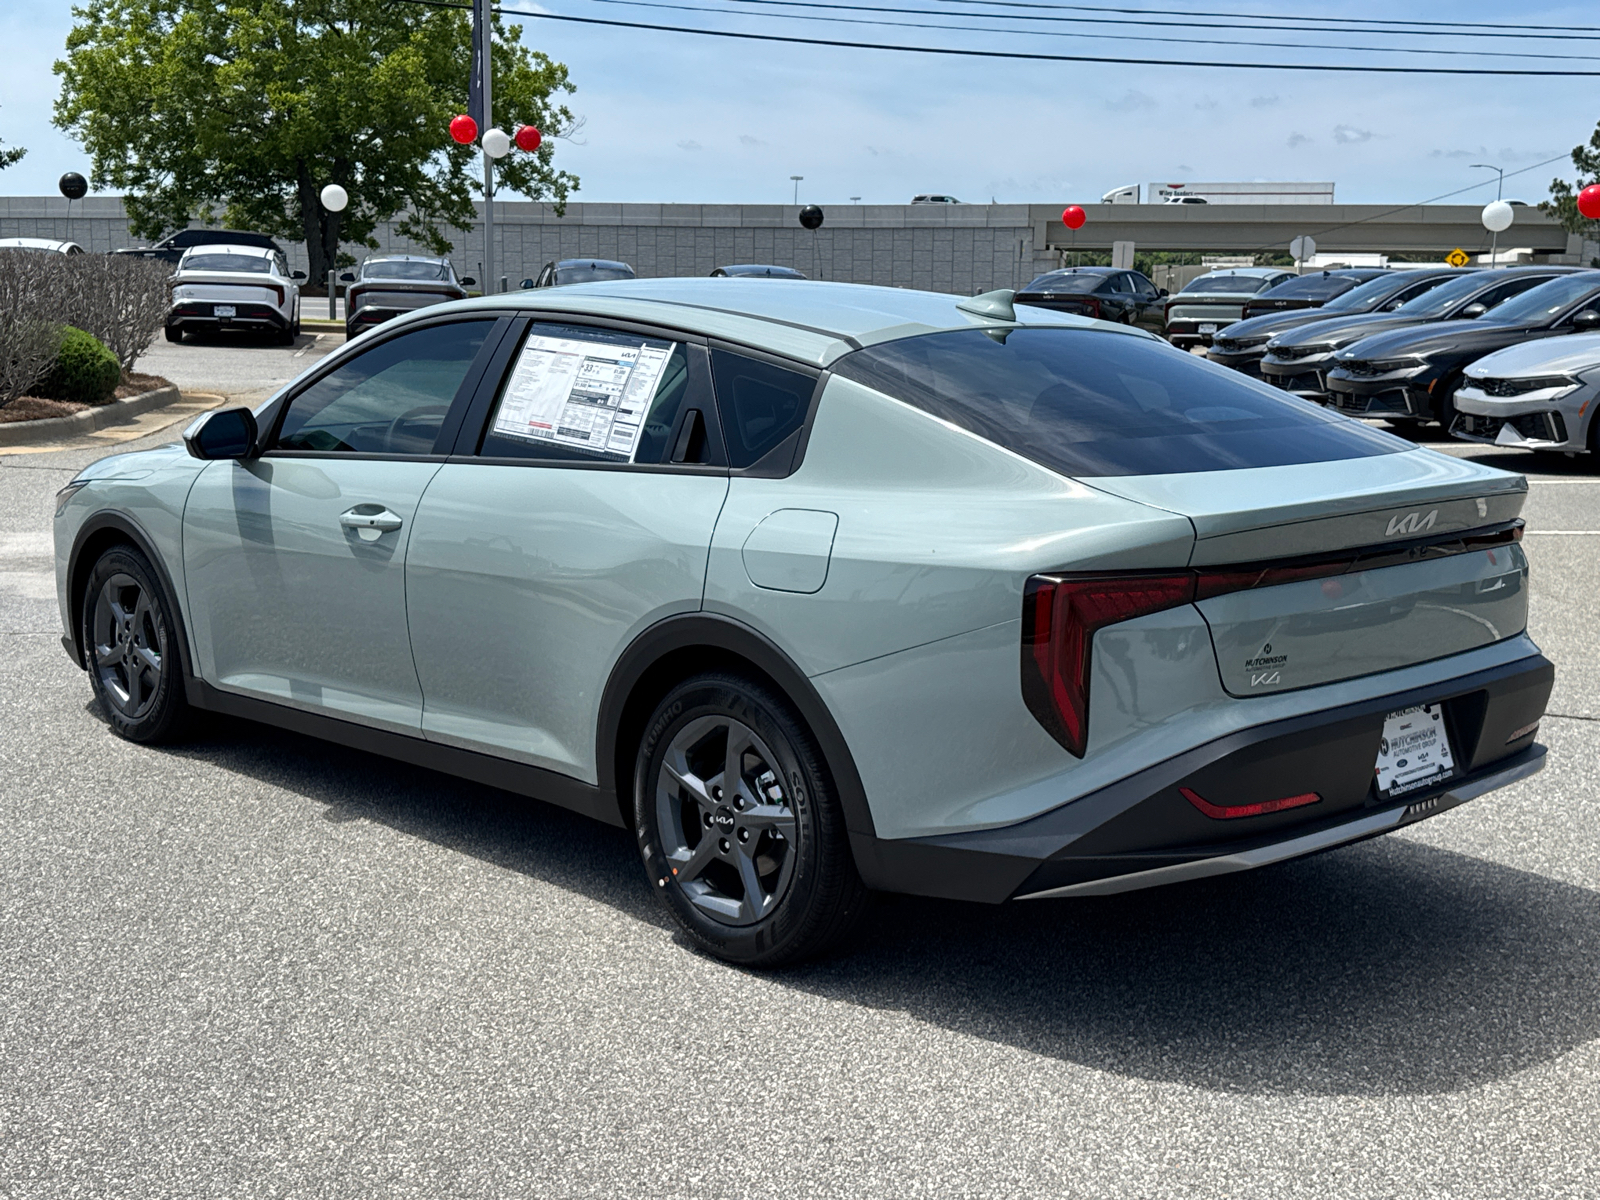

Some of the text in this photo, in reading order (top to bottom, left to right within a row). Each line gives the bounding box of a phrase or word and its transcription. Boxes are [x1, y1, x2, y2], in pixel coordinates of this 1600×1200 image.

[1384, 509, 1439, 536] KIA
[1245, 655, 1288, 667] HUTCHINSON
[1251, 671, 1281, 687] K4
[644, 700, 682, 757] KUMHO
[1391, 726, 1437, 751] HUTCHINSON
[1393, 738, 1437, 758] AUTOMOTIVE GROUP
[715, 815, 734, 825] KIA
